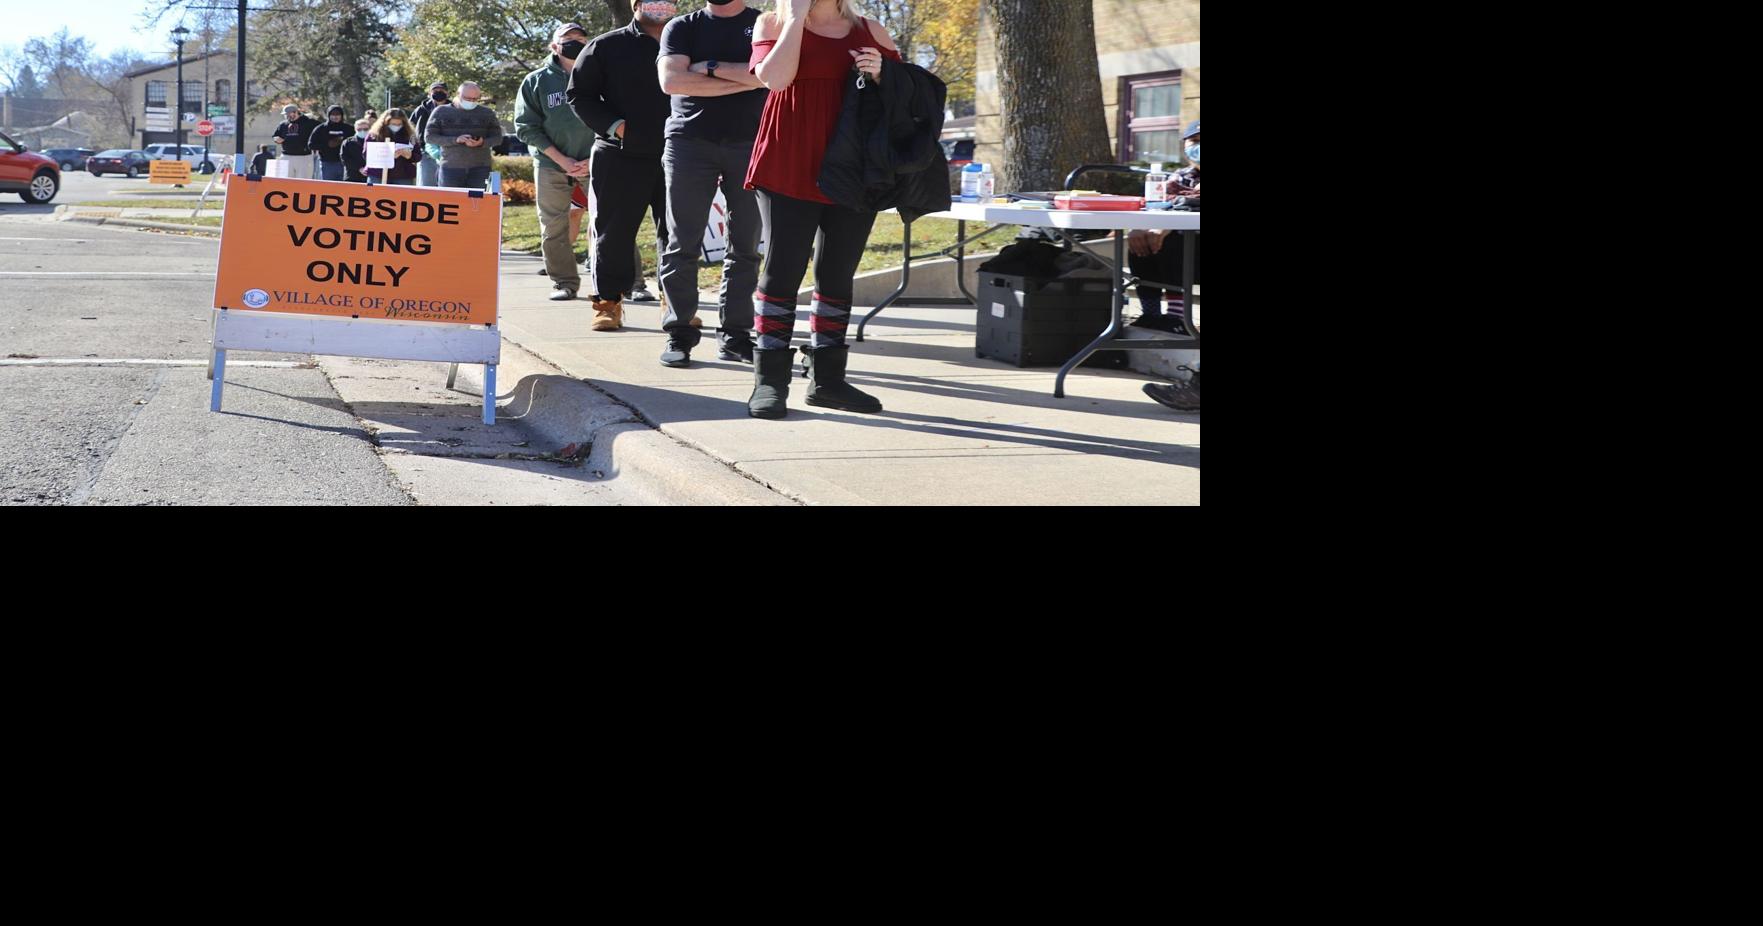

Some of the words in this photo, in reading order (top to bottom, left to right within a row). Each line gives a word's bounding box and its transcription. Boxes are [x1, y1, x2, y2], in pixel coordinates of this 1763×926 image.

[263, 190, 460, 225] CURBSIDE
[287, 225, 431, 255] VOTING
[306, 260, 410, 287] ONLY
[273, 290, 353, 308] VILLAGE
[359, 296, 385, 309] OF
[390, 298, 472, 314] OREGON
[384, 305, 471, 321] Wisconsin
